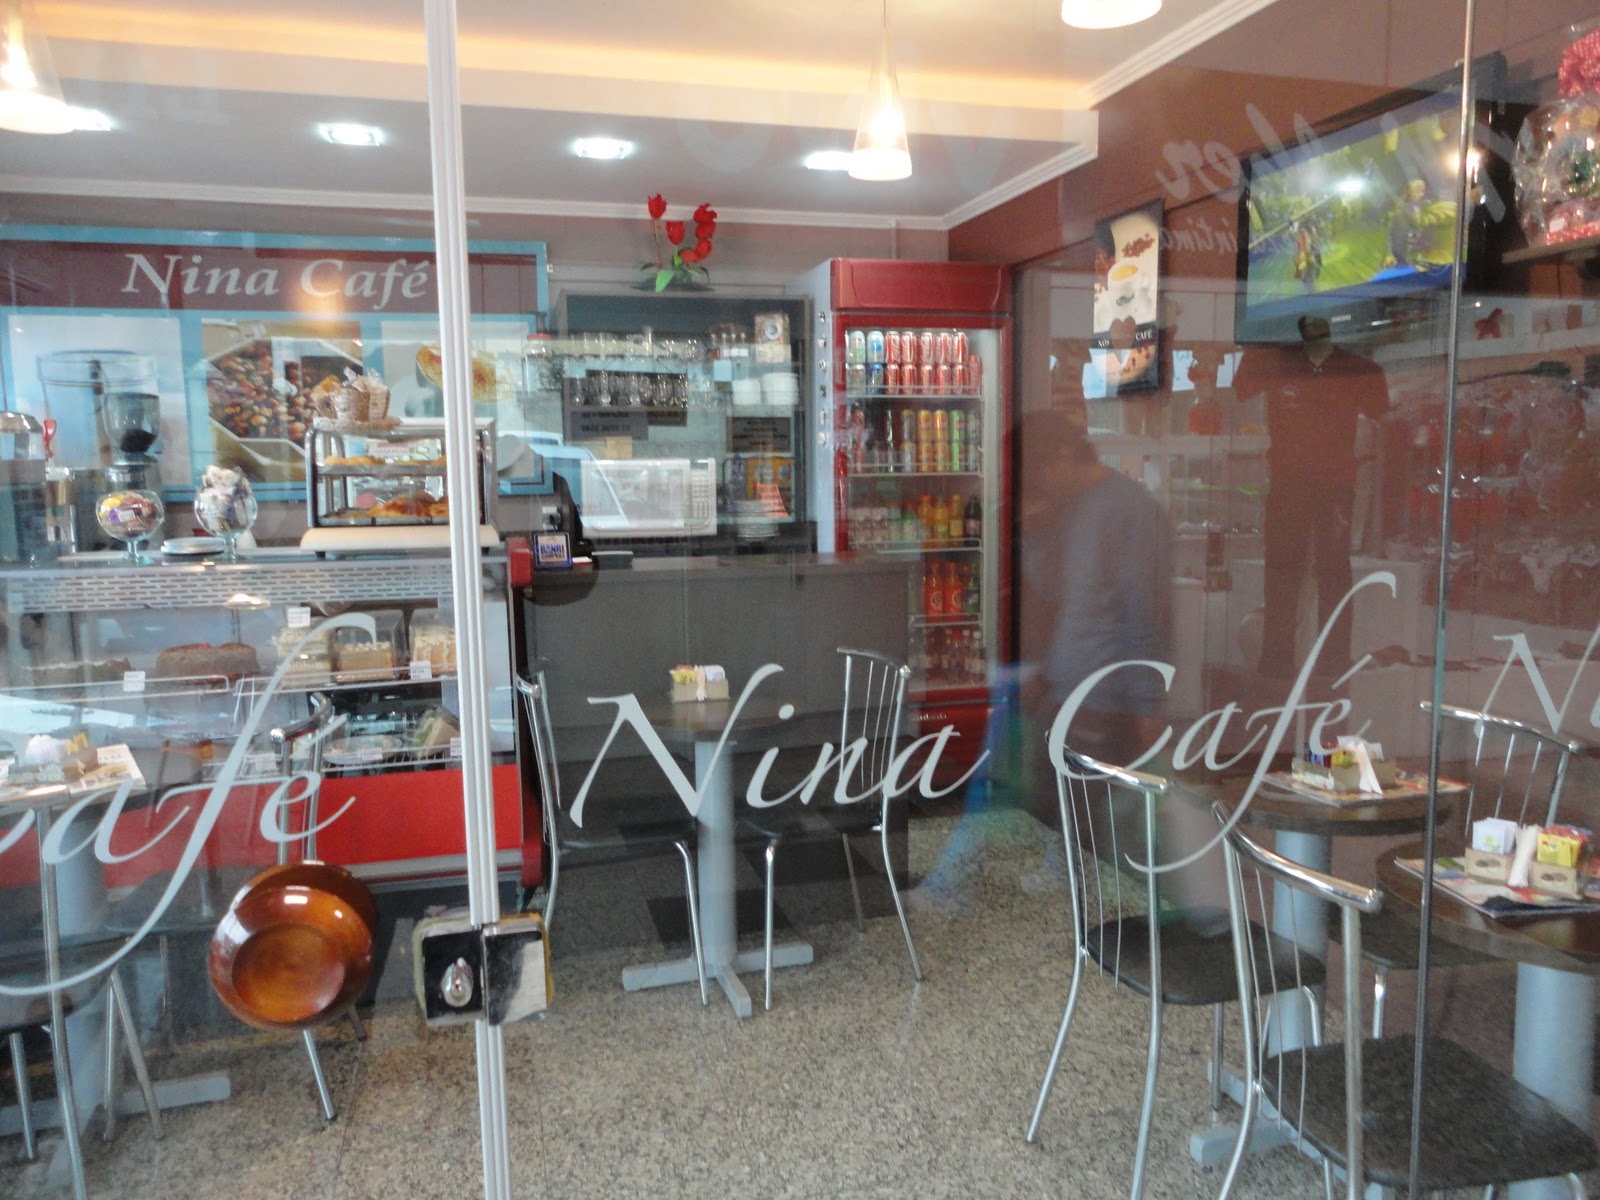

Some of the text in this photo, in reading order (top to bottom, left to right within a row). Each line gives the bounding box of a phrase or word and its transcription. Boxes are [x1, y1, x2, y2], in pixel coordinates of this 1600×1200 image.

[121, 253, 430, 311] Nina Café
[0, 613, 376, 997] afé
[569, 570, 1396, 874] Nina Café
